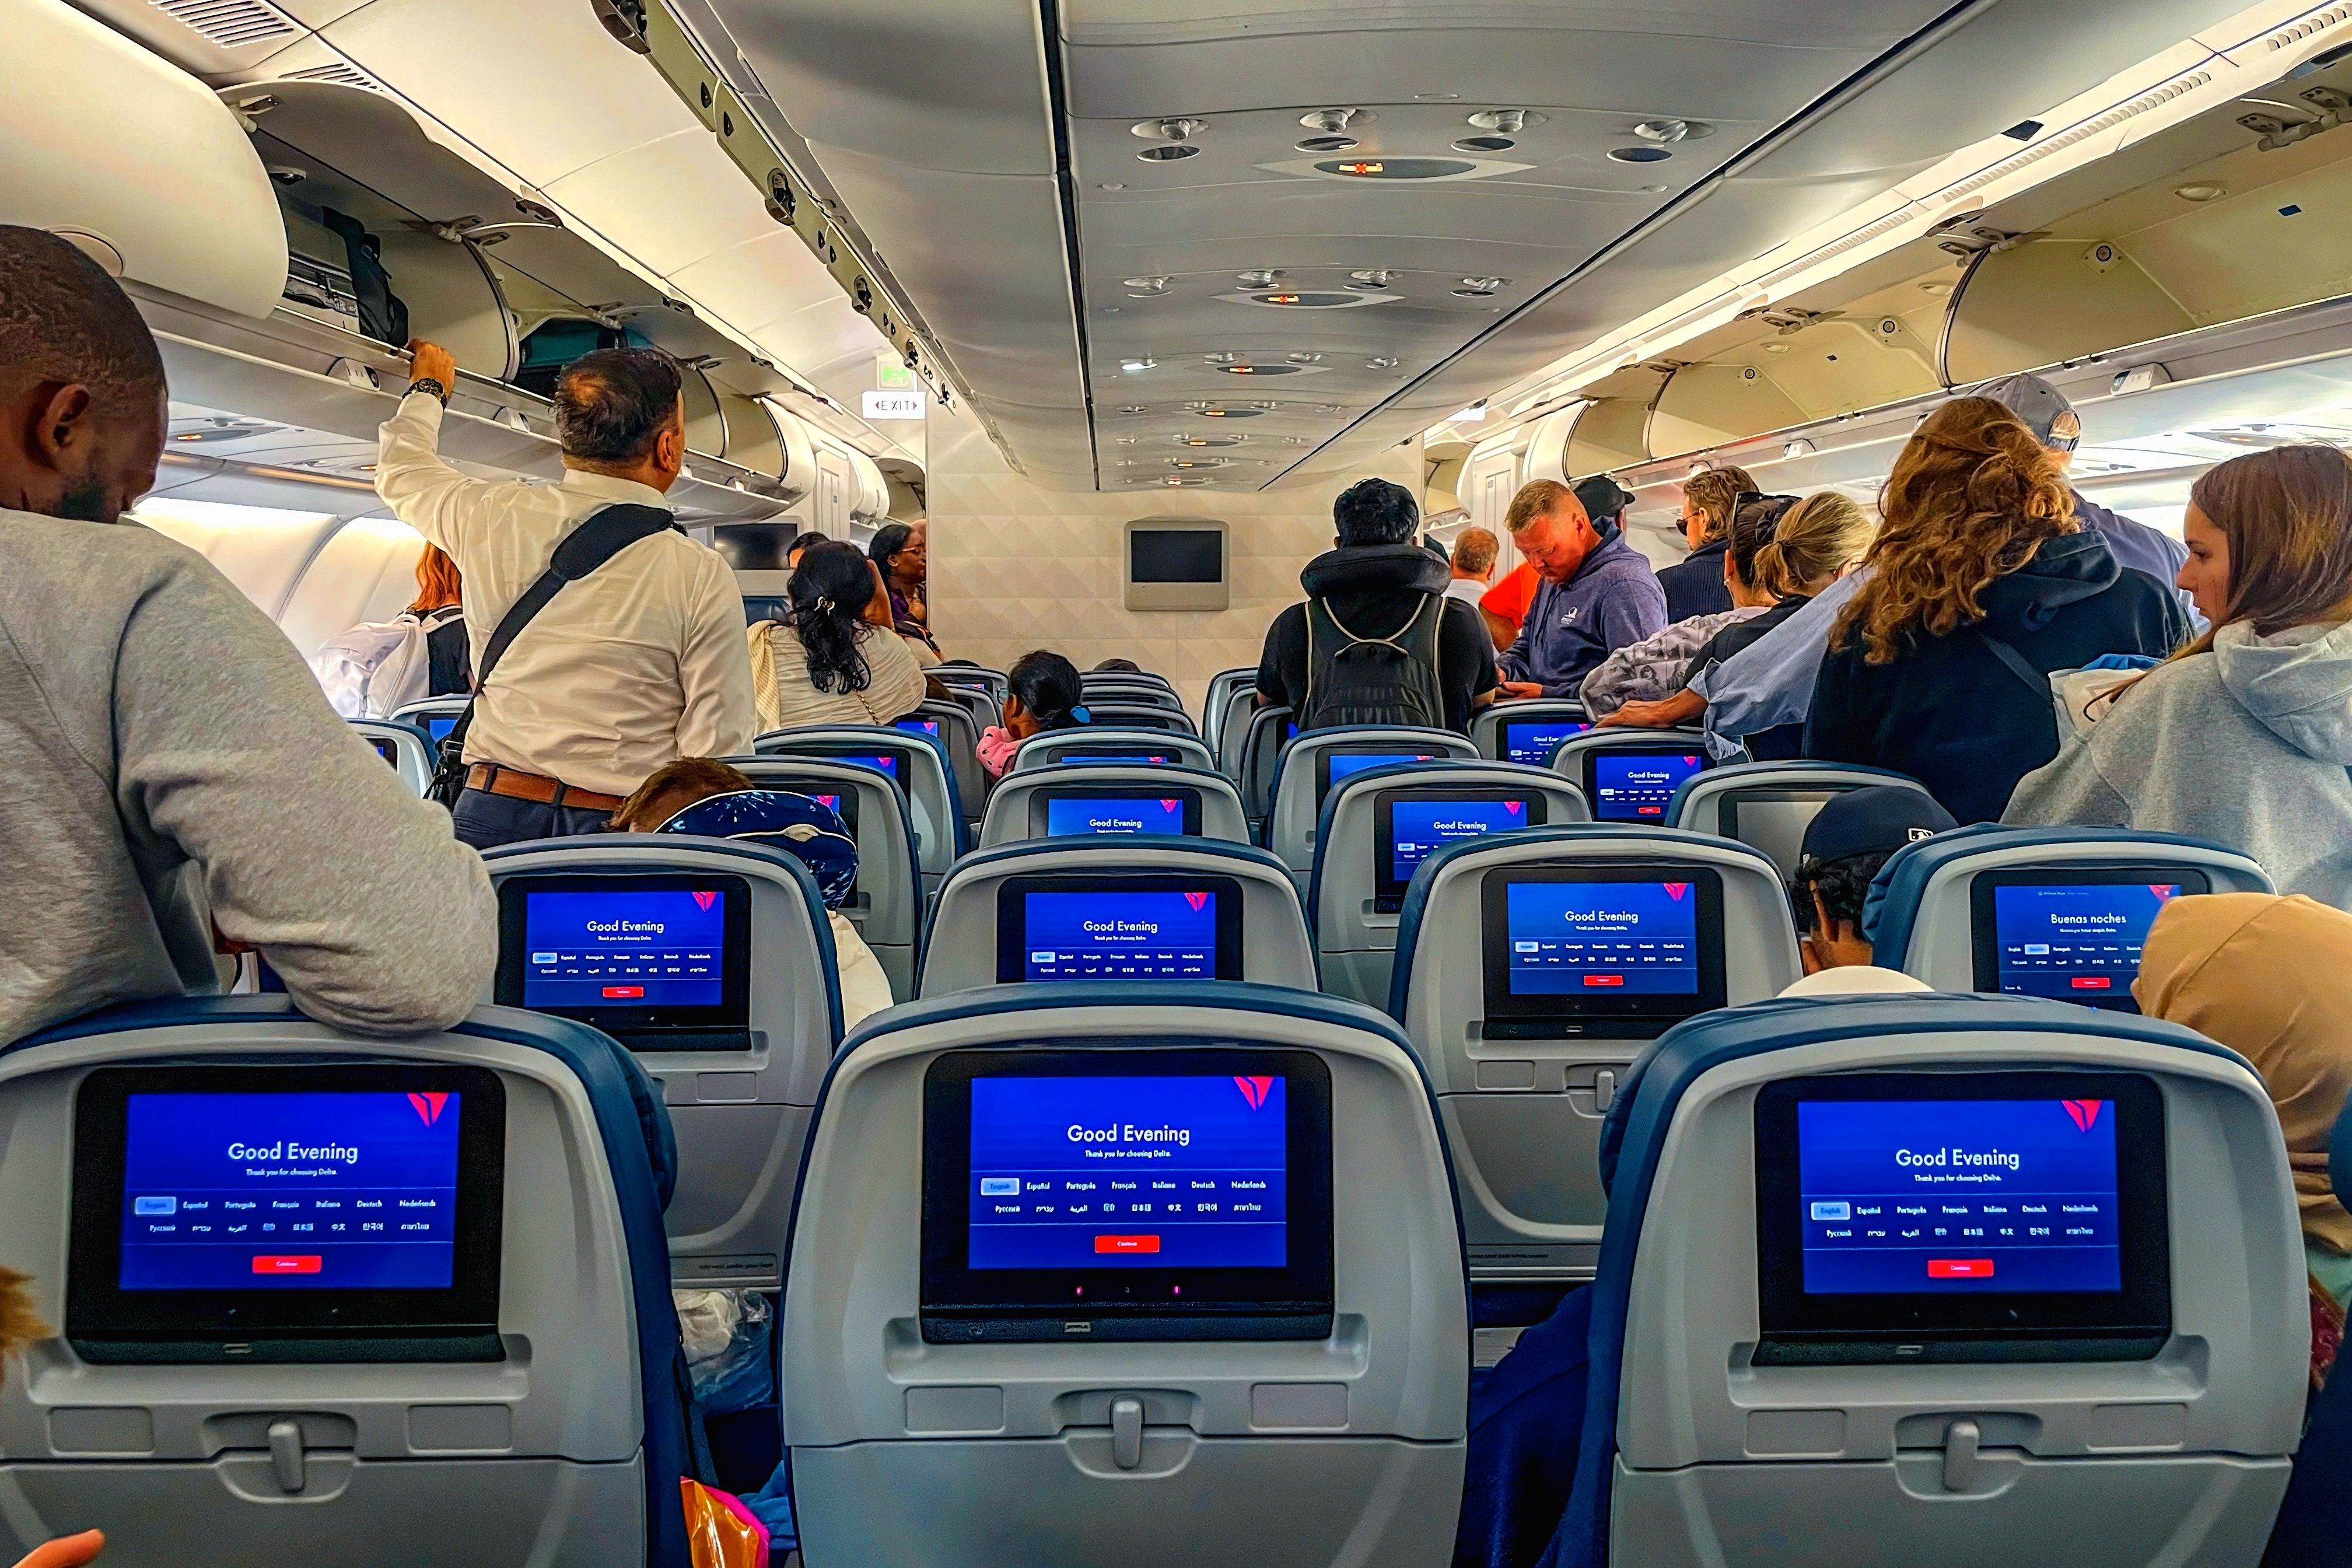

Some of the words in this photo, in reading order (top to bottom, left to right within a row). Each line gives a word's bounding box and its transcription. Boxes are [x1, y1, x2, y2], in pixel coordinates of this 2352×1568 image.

[881, 400, 910, 411] EXIT
[1646, 771, 1670, 780] Evening
[1114, 819, 1142, 828] Evening
[1458, 821, 1486, 831] Evening
[1565, 911, 1595, 921] Good
[1599, 911, 1638, 923] Evening
[2051, 914, 2087, 923] Buenas
[2091, 913, 2126, 923] noches
[587, 920, 618, 931] Good
[622, 921, 664, 933] Evening
[1084, 921, 1114, 931] Good
[1118, 921, 1157, 933] Evening
[1068, 1124, 1116, 1142] Good
[1124, 1125, 1189, 1146] Evening
[228, 1141, 281, 1160] Good
[288, 1143, 358, 1164] Evening
[1126, 1150, 1152, 1158] choosing
[1896, 1147, 1946, 1166] Good
[1953, 1149, 2019, 1170] Evening
[289, 1168, 317, 1177] choosing
[1957, 1174, 1982, 1182] choosing
